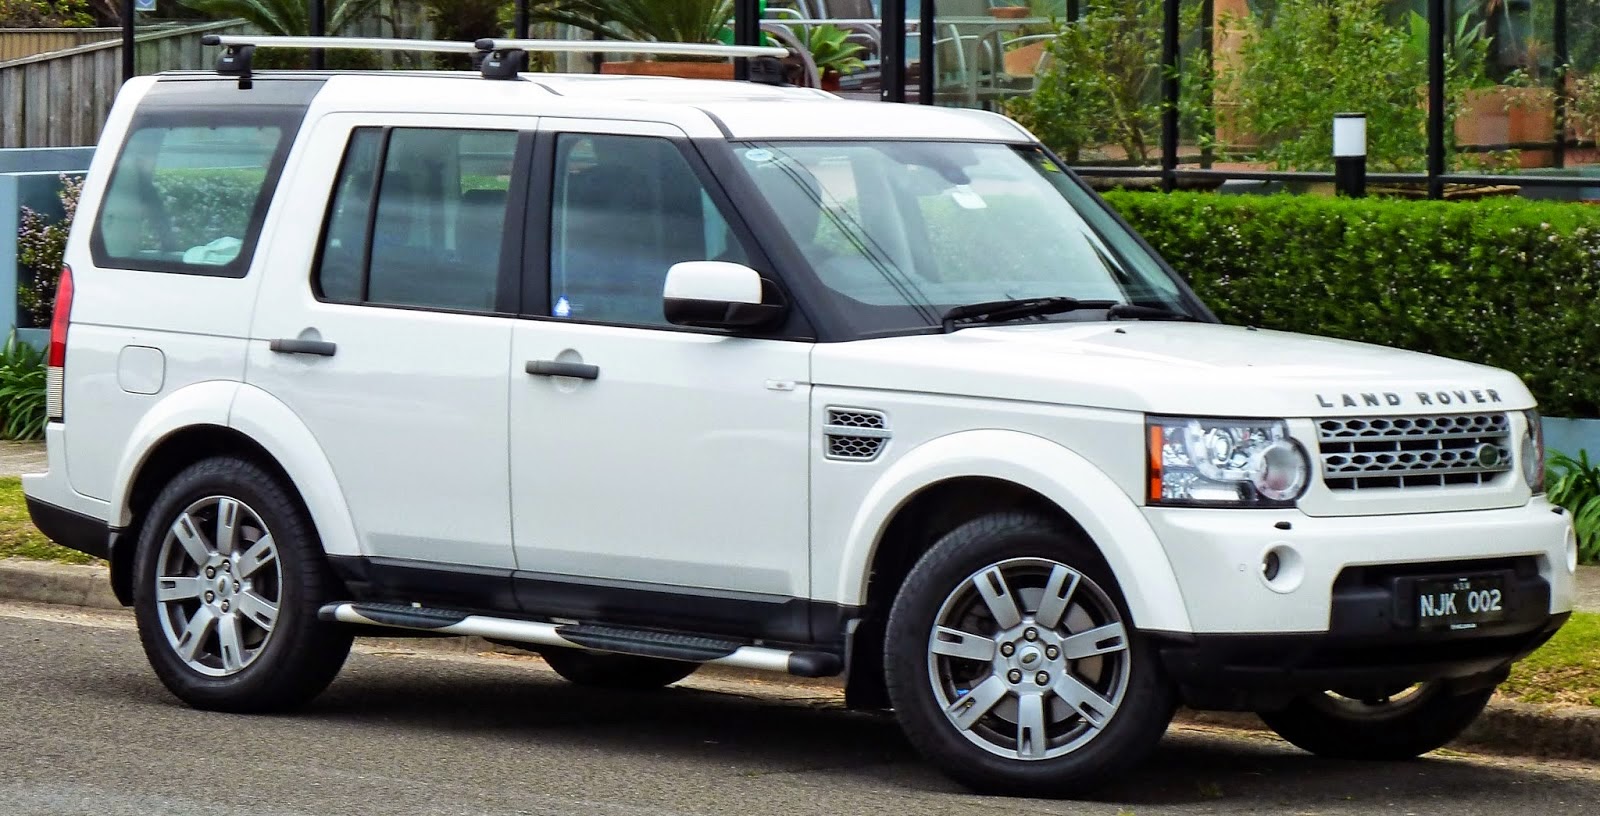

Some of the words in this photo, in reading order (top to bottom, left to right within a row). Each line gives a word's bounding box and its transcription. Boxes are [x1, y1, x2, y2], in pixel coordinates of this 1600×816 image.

[1316, 392, 1401, 408] LAND
[1416, 388, 1502, 405] ROVER
[1420, 593, 1457, 617] NJK
[1468, 589, 1502, 613] 002
